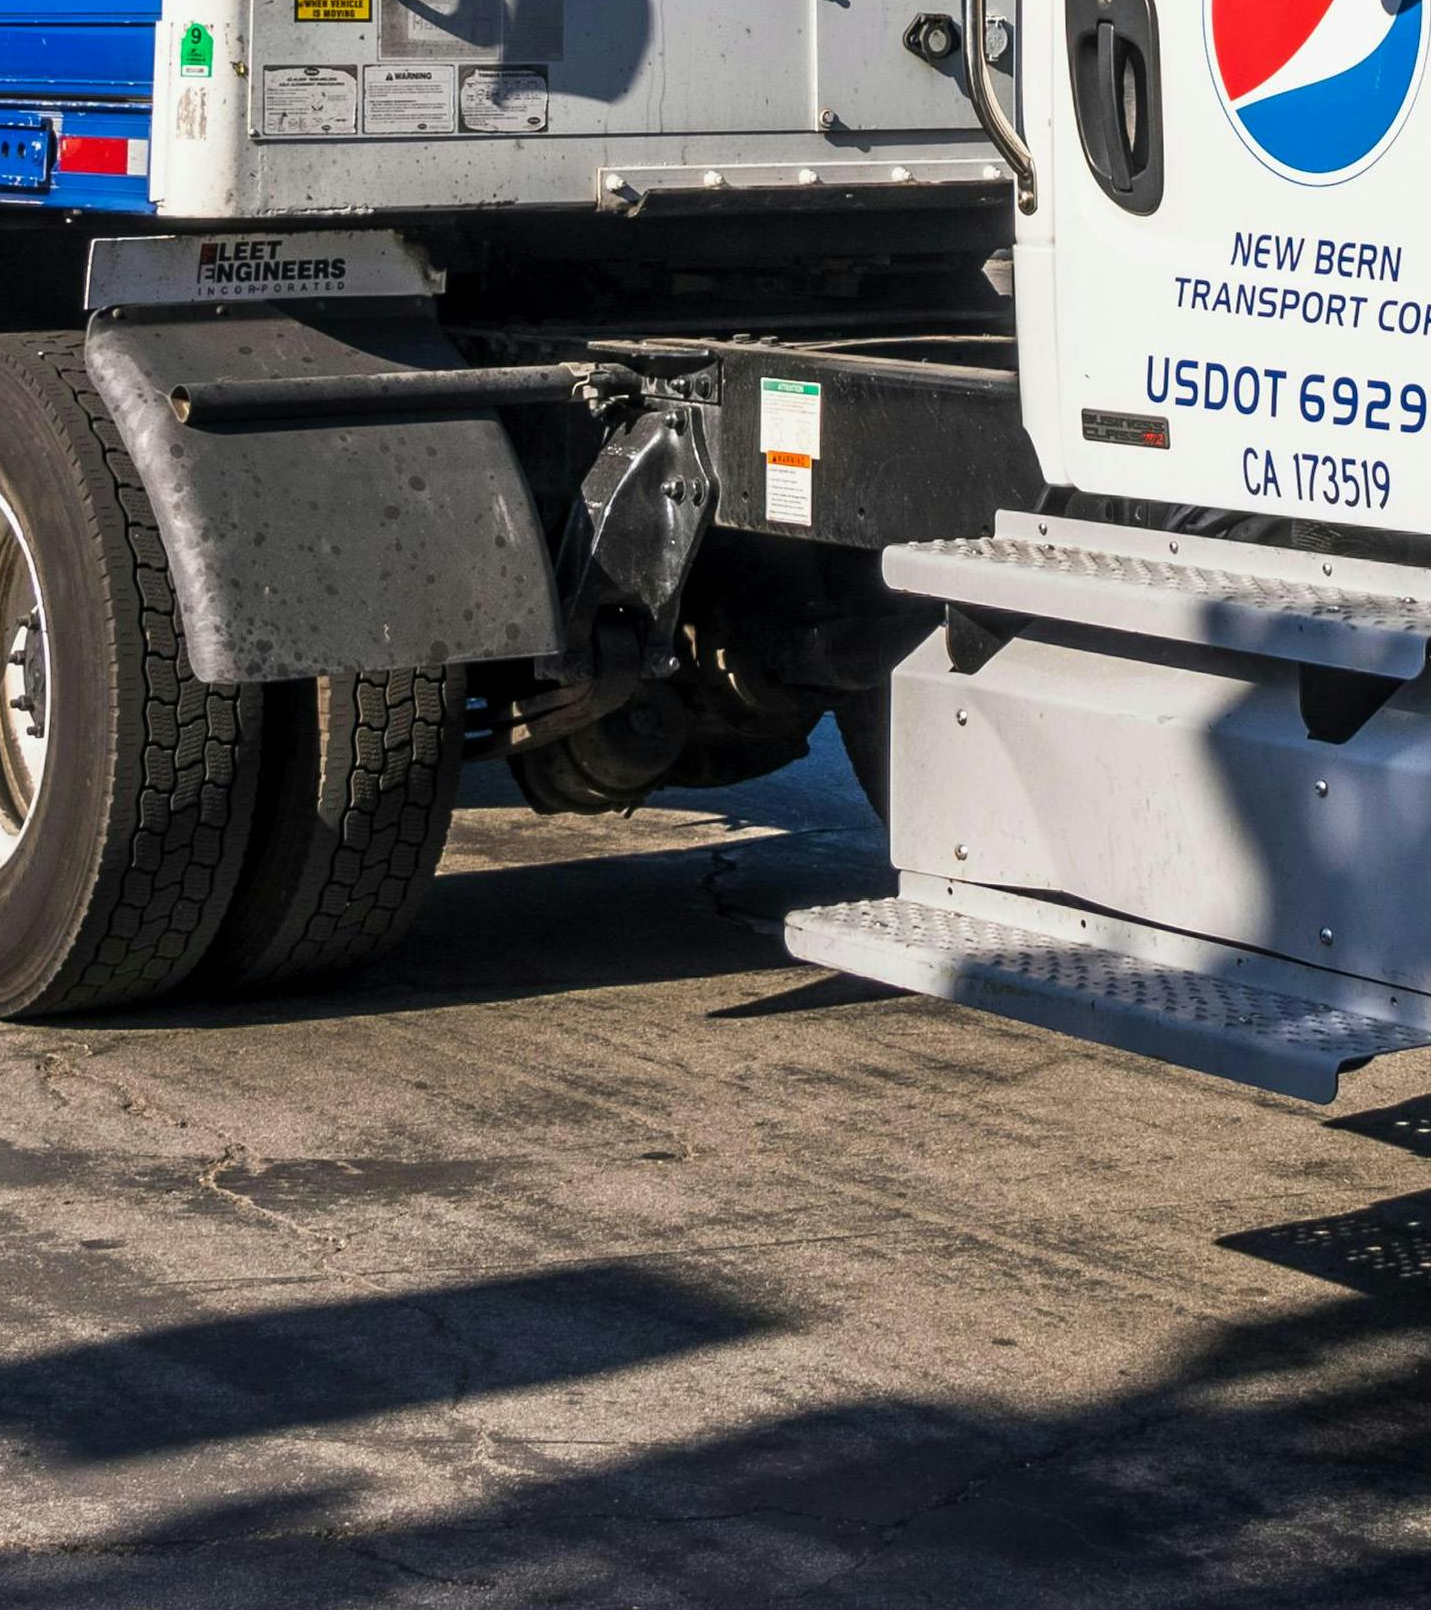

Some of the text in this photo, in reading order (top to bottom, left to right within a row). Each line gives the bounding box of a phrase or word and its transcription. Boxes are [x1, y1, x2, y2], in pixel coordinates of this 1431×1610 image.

[303, 0, 364, 9] WHEN VEHICLE
[312, 10, 356, 18] IS MOVING
[190, 26, 203, 45] 9
[394, 71, 433, 81] WARNING
[1230, 231, 1403, 283] NEW BERN
[197, 280, 346, 296] INCORPORATED
[1174, 277, 1369, 330] TRANSPORT
[1146, 354, 1288, 418] USDOT
[1242, 446, 1392, 510] CA 173519
